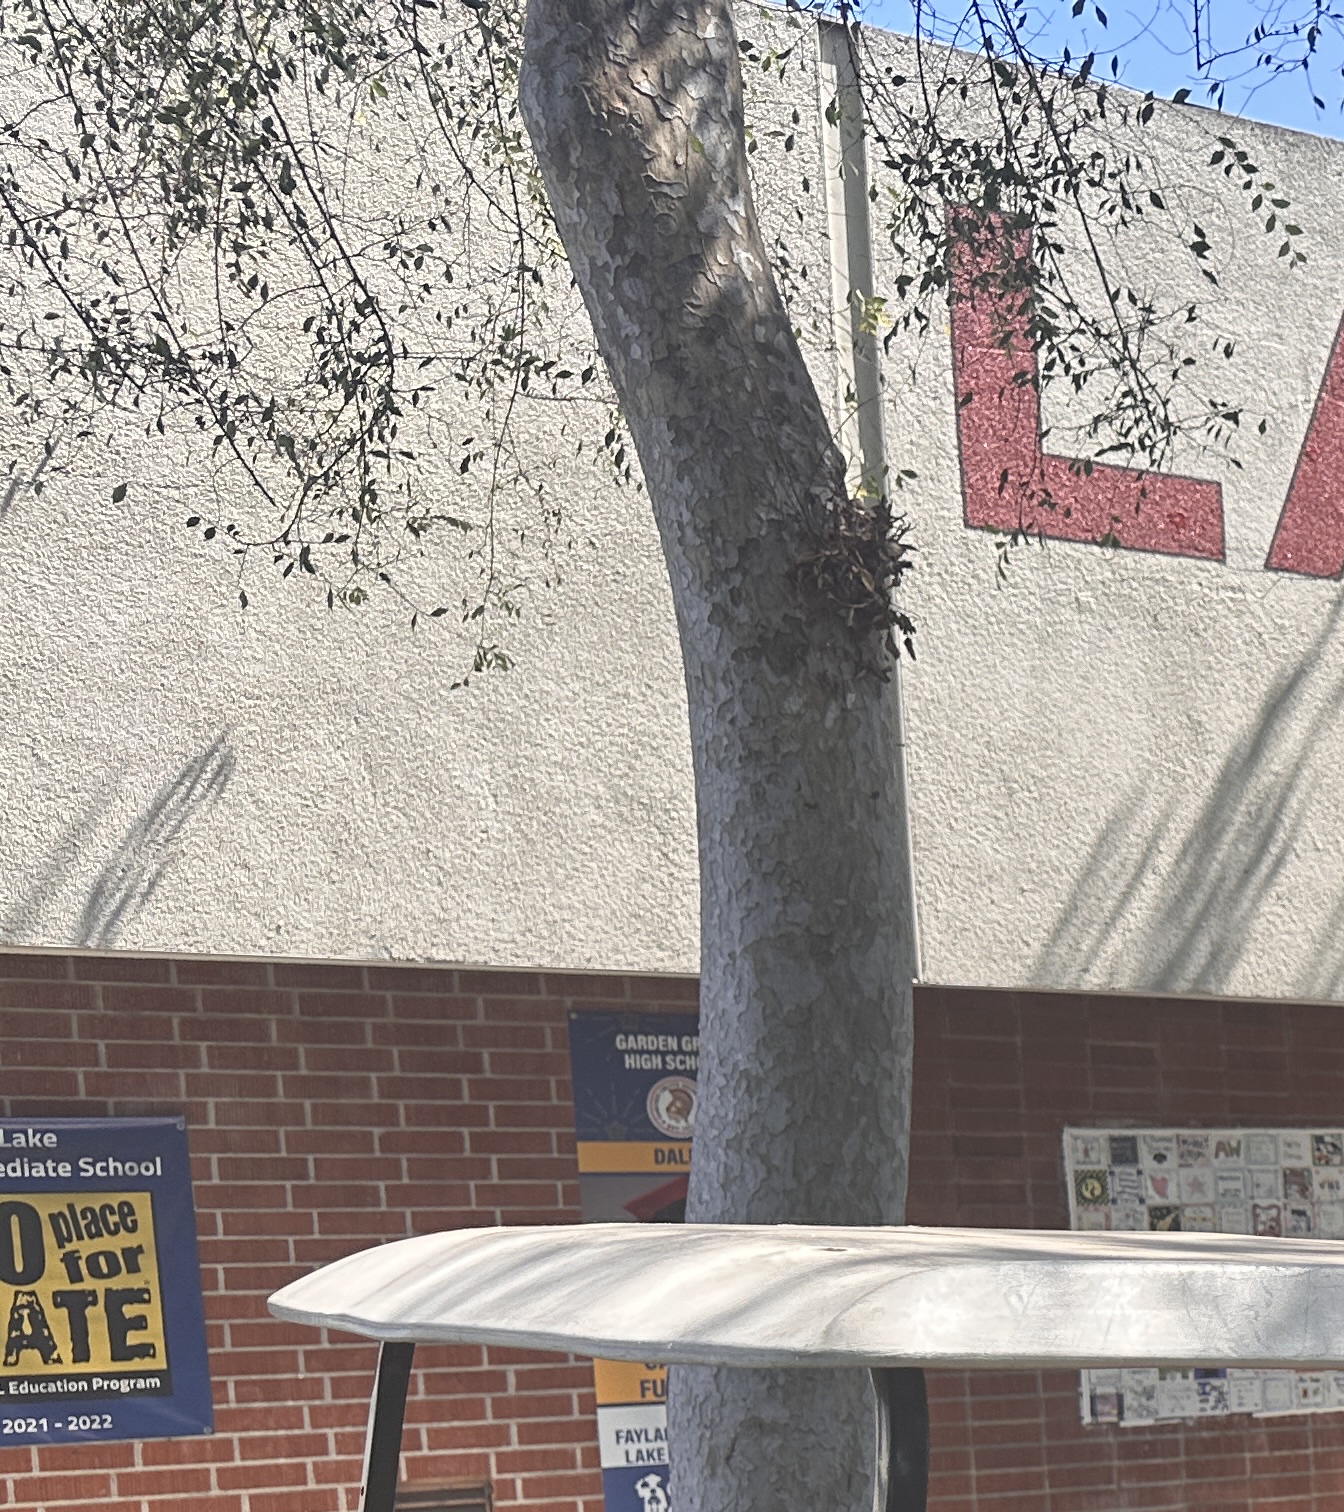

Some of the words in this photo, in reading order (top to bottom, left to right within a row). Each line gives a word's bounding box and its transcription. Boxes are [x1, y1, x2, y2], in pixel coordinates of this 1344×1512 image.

[615, 1034, 678, 1051] GARDEN
[624, 1054, 662, 1069] HIGH
[0, 1128, 58, 1148] Lake
[78, 1156, 162, 1177] School
[48, 1201, 138, 1249] place
[60, 1244, 144, 1285] for
[8, 1380, 88, 1395] Education
[92, 1376, 161, 1394] Program
[2, 1418, 48, 1434] 2021
[67, 1414, 113, 1431] 2022
[625, 1448, 665, 1465] LAKE
